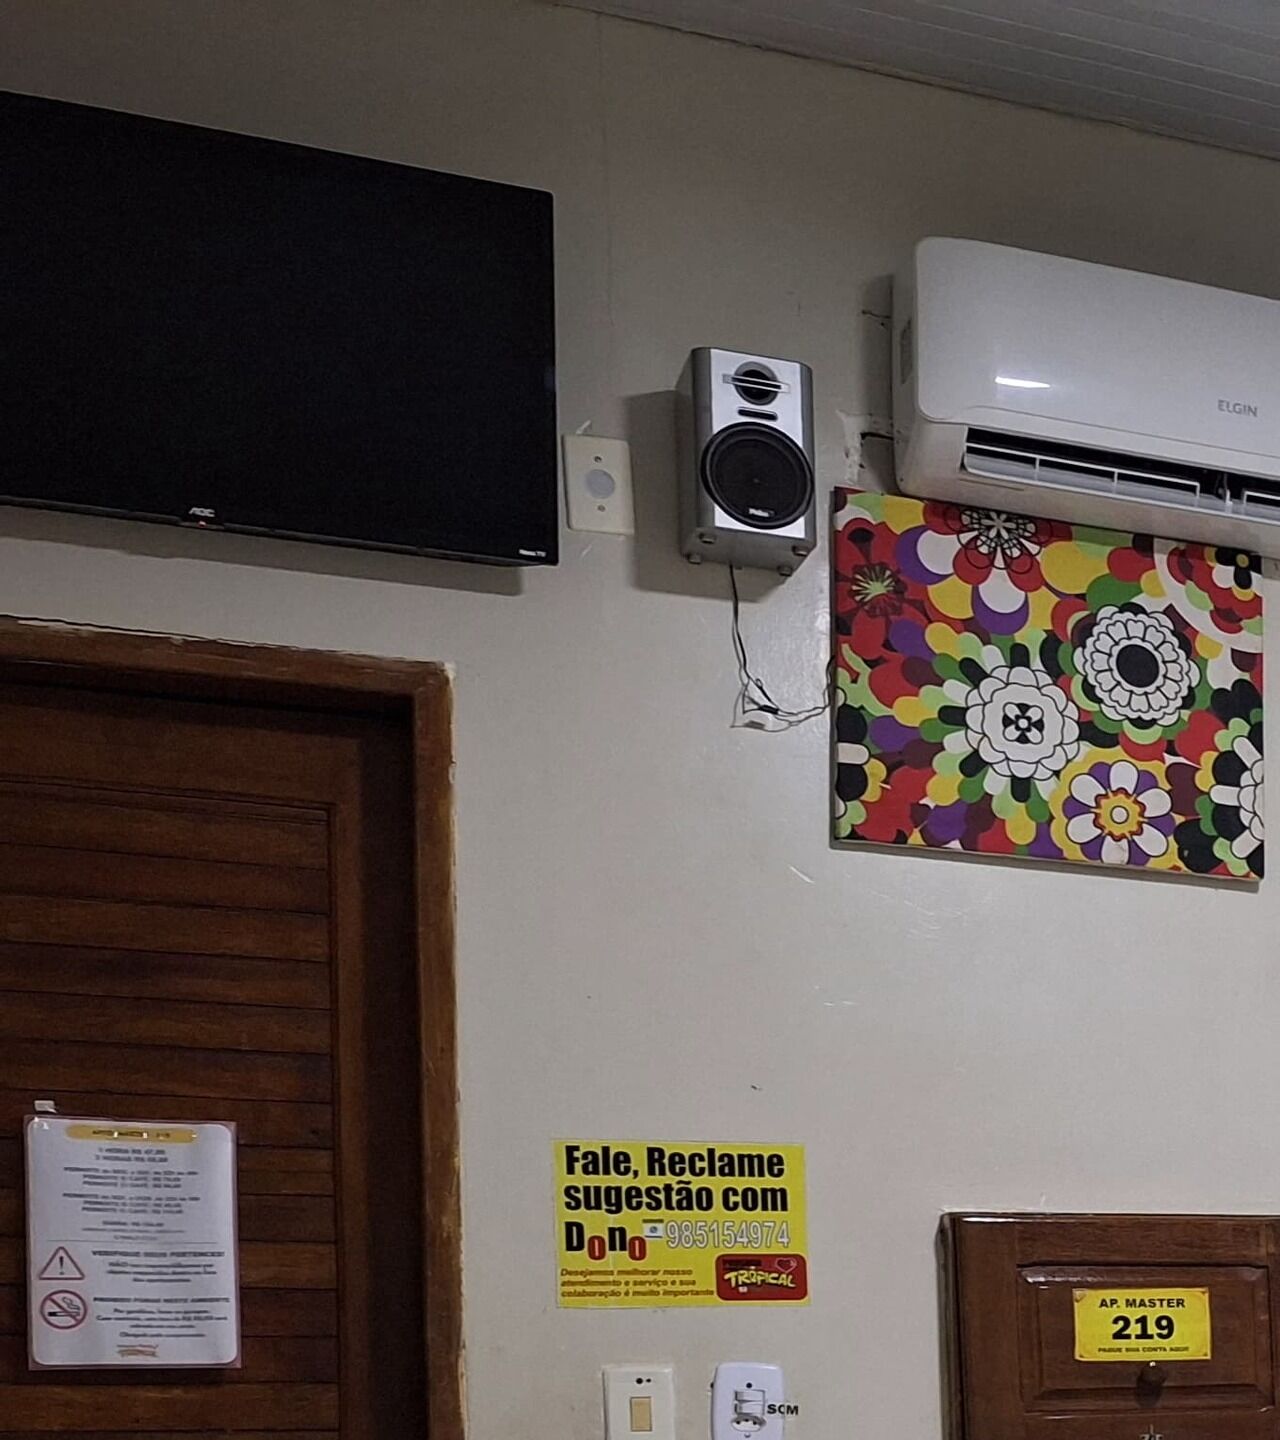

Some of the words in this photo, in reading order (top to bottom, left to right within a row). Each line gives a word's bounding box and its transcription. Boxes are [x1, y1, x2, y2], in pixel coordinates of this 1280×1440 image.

[1217, 399, 1258, 418] ELGIN
[564, 1145, 640, 1179] Fale,
[646, 1146, 786, 1179] Reclame
[563, 1179, 714, 1215] sugestão
[721, 1184, 789, 1213] com
[664, 1219, 791, 1249] 985154974
[1098, 1298, 1120, 1309] AP.
[1125, 1298, 1186, 1309] MASTER
[1111, 1314, 1175, 1340] 219
